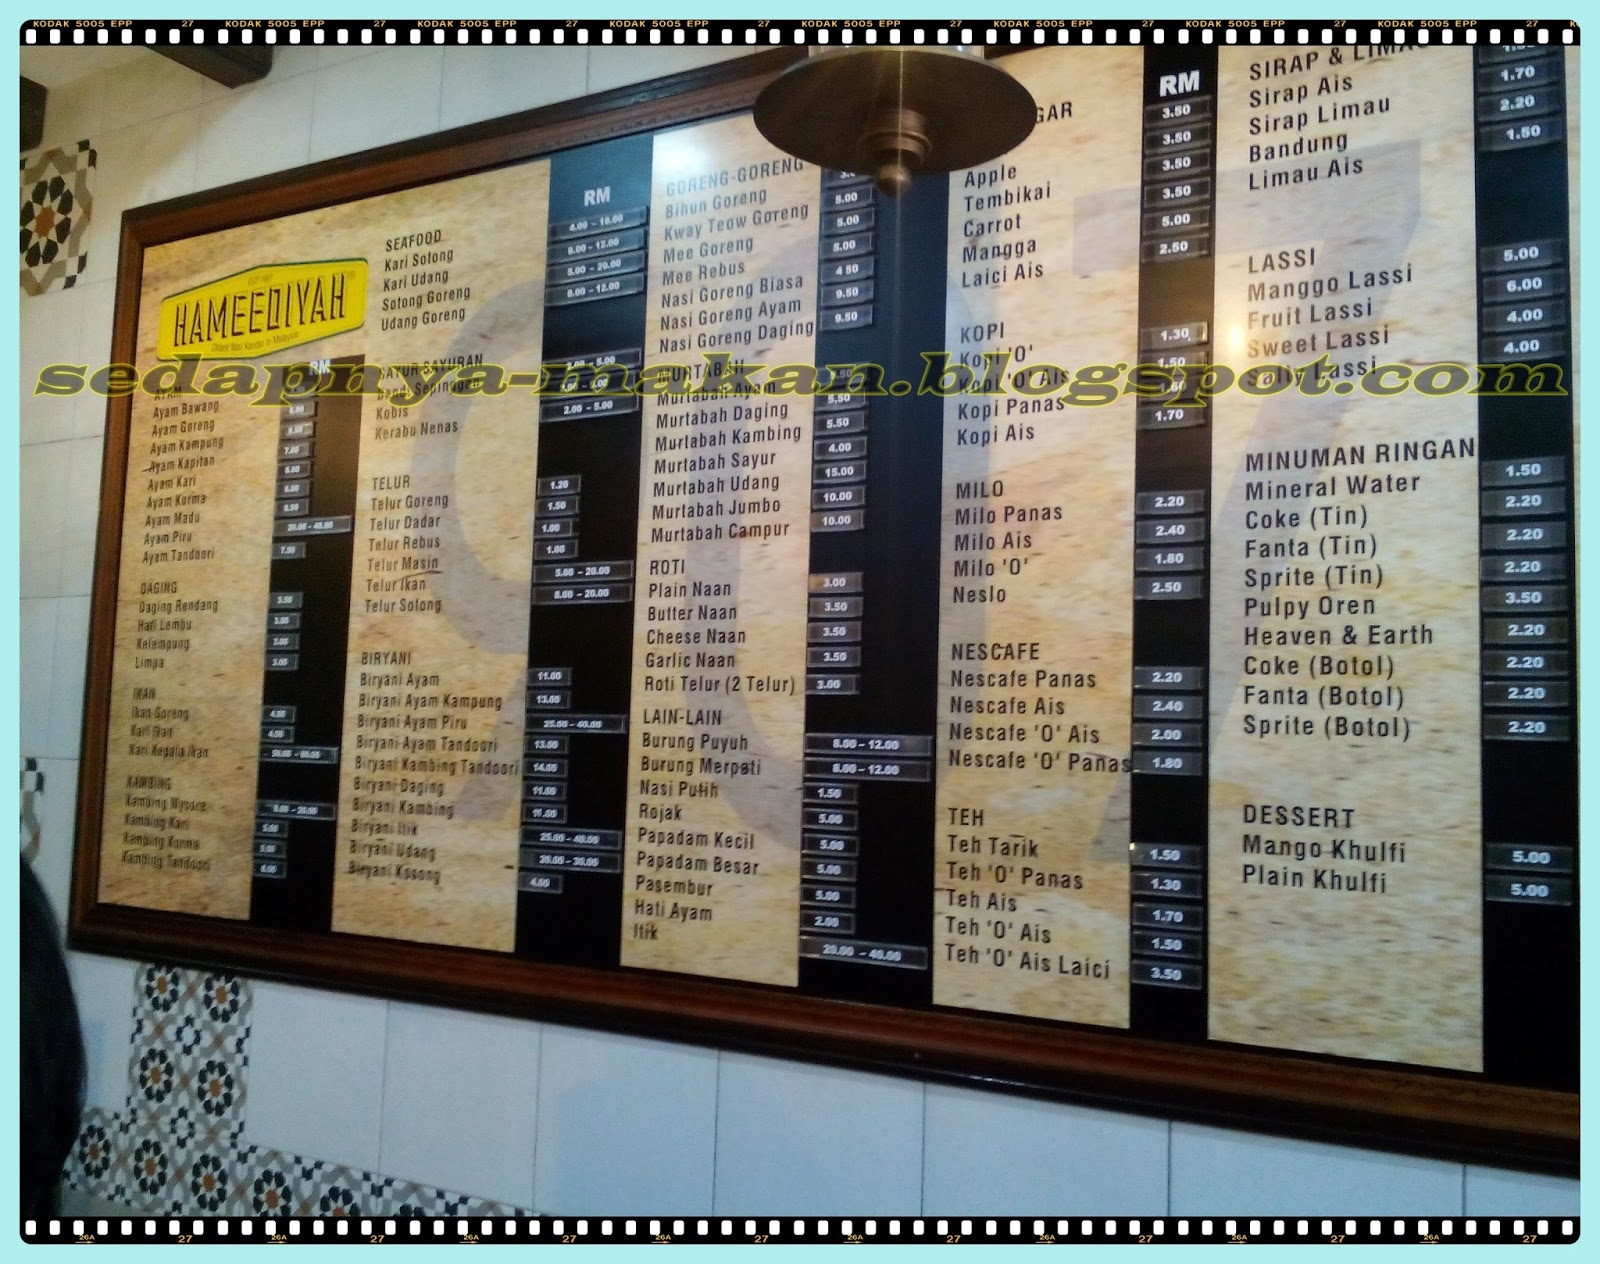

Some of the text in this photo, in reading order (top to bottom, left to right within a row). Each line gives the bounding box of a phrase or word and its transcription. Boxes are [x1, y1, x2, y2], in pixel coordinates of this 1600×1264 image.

[1250, 51, 1319, 81] SIRAP
[1329, 46, 1344, 65] &
[1159, 70, 1199, 97] RM
[1250, 75, 1353, 108] Sirap Ais
[1162, 104, 1191, 119] 3.50
[1500, 95, 1535, 112] 2.20
[1250, 97, 1391, 135] Sirap Limau
[1506, 124, 1541, 140] 1.50
[1250, 133, 1347, 163] Bandung
[965, 165, 1017, 188] Apple
[1250, 157, 1363, 190] Limau Ais
[584, 186, 610, 206] RM
[666, 189, 767, 219] Bihun Goreng
[964, 181, 1050, 212] Tembikai
[664, 204, 809, 241] Kway Teow Goreng
[964, 214, 1021, 237] Carrot
[386, 229, 442, 252] SEAFOOD
[664, 237, 753, 264] Mee Goreng
[962, 239, 1037, 263] Mangga
[1159, 241, 1188, 255] 2.50
[385, 248, 454, 272] Kari Sotong
[1249, 248, 1315, 274] LASSI
[1504, 247, 1539, 262] 5.00
[962, 262, 1043, 288] Laici Ais
[1248, 263, 1412, 301] Manggo Lassi
[1506, 277, 1542, 292] 6.00
[662, 274, 803, 308] Nasi Goreng Biasa
[174, 273, 345, 346] HAMEEDIYAH
[1247, 298, 1372, 330] Fruit Lassi
[1506, 308, 1543, 323] 4.00
[961, 322, 1004, 343] KOPI
[1247, 325, 1389, 358] Sweet Lassi
[153, 405, 179, 421] Ayam
[376, 407, 409, 421] Kobis
[656, 403, 788, 428] Murtabah Daging
[958, 397, 1065, 422] Kopi Panas
[1155, 409, 1184, 421] 1.70
[655, 425, 801, 451] Murtabah Kambing
[957, 424, 1034, 448] Kopi Ais
[1245, 438, 1475, 472] MINUMAN RINGAN
[825, 466, 854, 477] 15.00
[1506, 464, 1541, 477] 1.50
[372, 475, 410, 490] TELUR
[956, 480, 1004, 499] MILO
[1246, 474, 1420, 501] Mineral Water
[371, 494, 448, 511] Telur Goreng
[1155, 496, 1185, 507] 2.20
[1505, 495, 1542, 507] 2.20
[370, 516, 440, 531] Telur Dadar
[955, 505, 1063, 525] Milo Panas
[1246, 505, 1368, 531] Coke (Tin)
[954, 531, 1032, 551] Milo Ais
[1245, 534, 1377, 560] Fanta (Tin)
[650, 559, 685, 575] ROTI
[954, 560, 994, 577] Milo
[1155, 553, 1184, 564] 1.80
[823, 577, 846, 587] 3.00
[1245, 564, 1383, 591] Sprite (Tin)
[649, 582, 731, 598] Plain Naan
[953, 585, 1006, 603] Neslo
[1505, 592, 1542, 604] 3.50
[648, 606, 737, 622] Butter Naan
[1245, 597, 1375, 620] Pulpy Oren
[1244, 625, 1433, 646] Heaven & Earth
[361, 652, 411, 666] BIRYANI
[952, 642, 1040, 660] NESCAFE
[1244, 655, 1394, 681] Coke (Botol)
[360, 672, 439, 688] Biryani Ayam
[951, 670, 1097, 688] Nescafe Panas
[1152, 701, 1184, 712] 2.40
[1244, 686, 1404, 711] Fanta (Botol)
[643, 709, 722, 726] LAIN-LAIN
[950, 723, 1026, 741] Nescafe
[1068, 725, 1099, 744] Ais
[1243, 715, 1410, 742] Sprite (Botol)
[641, 733, 748, 752] Burung Puyuh
[949, 807, 984, 827] TEH
[1243, 805, 1355, 829] DESSERT
[638, 827, 754, 850] Papadam Kecil
[948, 834, 1039, 858] Teh Tarik
[1243, 835, 1406, 863] Mango Khulfi
[1150, 849, 1181, 861] 1.50
[1512, 850, 1550, 864] 5.00
[947, 861, 981, 882] Teh
[1022, 867, 1084, 890] Panas
[1242, 864, 1387, 894] Plain Khulfi
[1510, 883, 1550, 898] 5.00
[635, 899, 712, 923] Hati Ayam
[1151, 968, 1182, 981] 3.50
